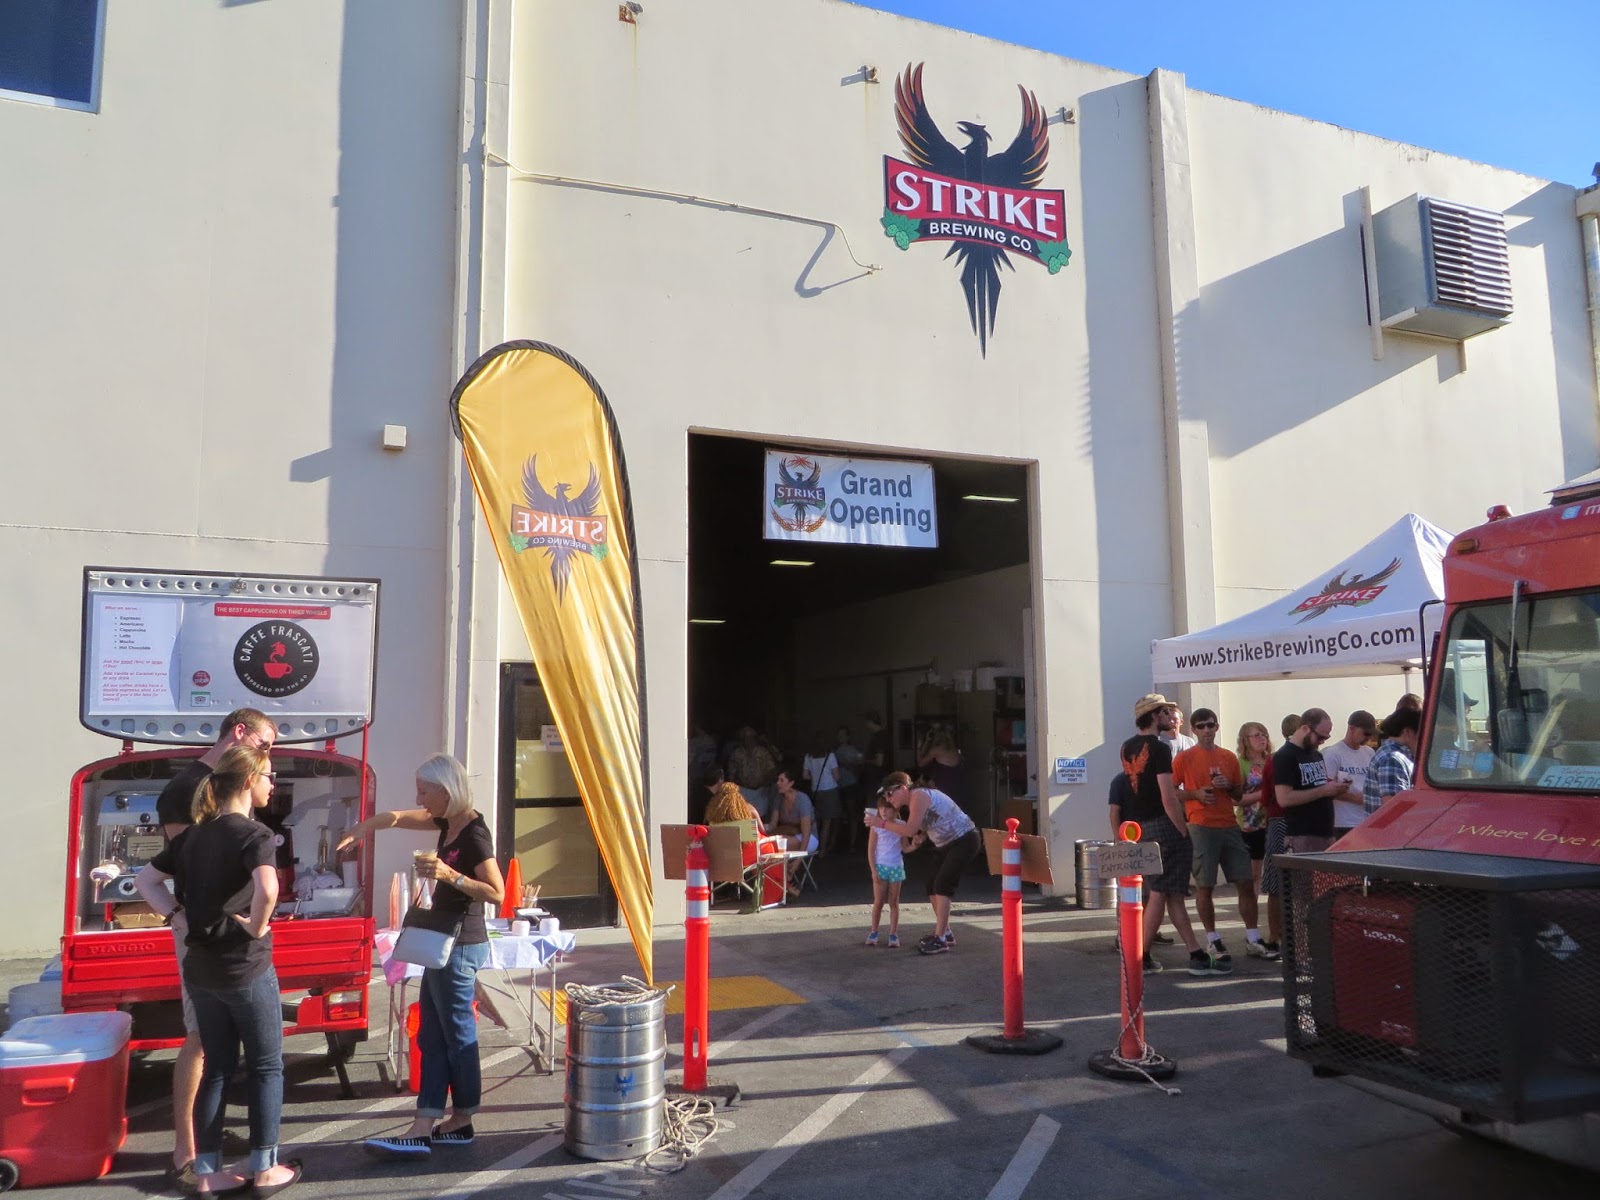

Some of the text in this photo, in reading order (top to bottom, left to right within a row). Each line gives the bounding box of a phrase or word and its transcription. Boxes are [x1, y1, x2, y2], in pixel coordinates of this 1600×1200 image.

[893, 171, 1057, 238] STRIKE
[929, 222, 1033, 253] BREWING CO.
[777, 486, 823, 501] STRIKE
[840, 469, 913, 498] Grand
[830, 497, 932, 533] Opening
[1300, 587, 1381, 610] STRIKE
[240, 625, 313, 663] CAFFE FRASCATI
[1175, 625, 1415, 669] www.StrikeBrewingCo.com
[243, 672, 273, 693] ESPRESSO
[287, 682, 299, 690] THE
[1058, 759, 1084, 767] NOTICE
[1457, 824, 1529, 840] Where
[1533, 828, 1586, 846] love
[1101, 860, 1145, 873] ENTRANCE
[88, 942, 156, 955] PIAGGIO
